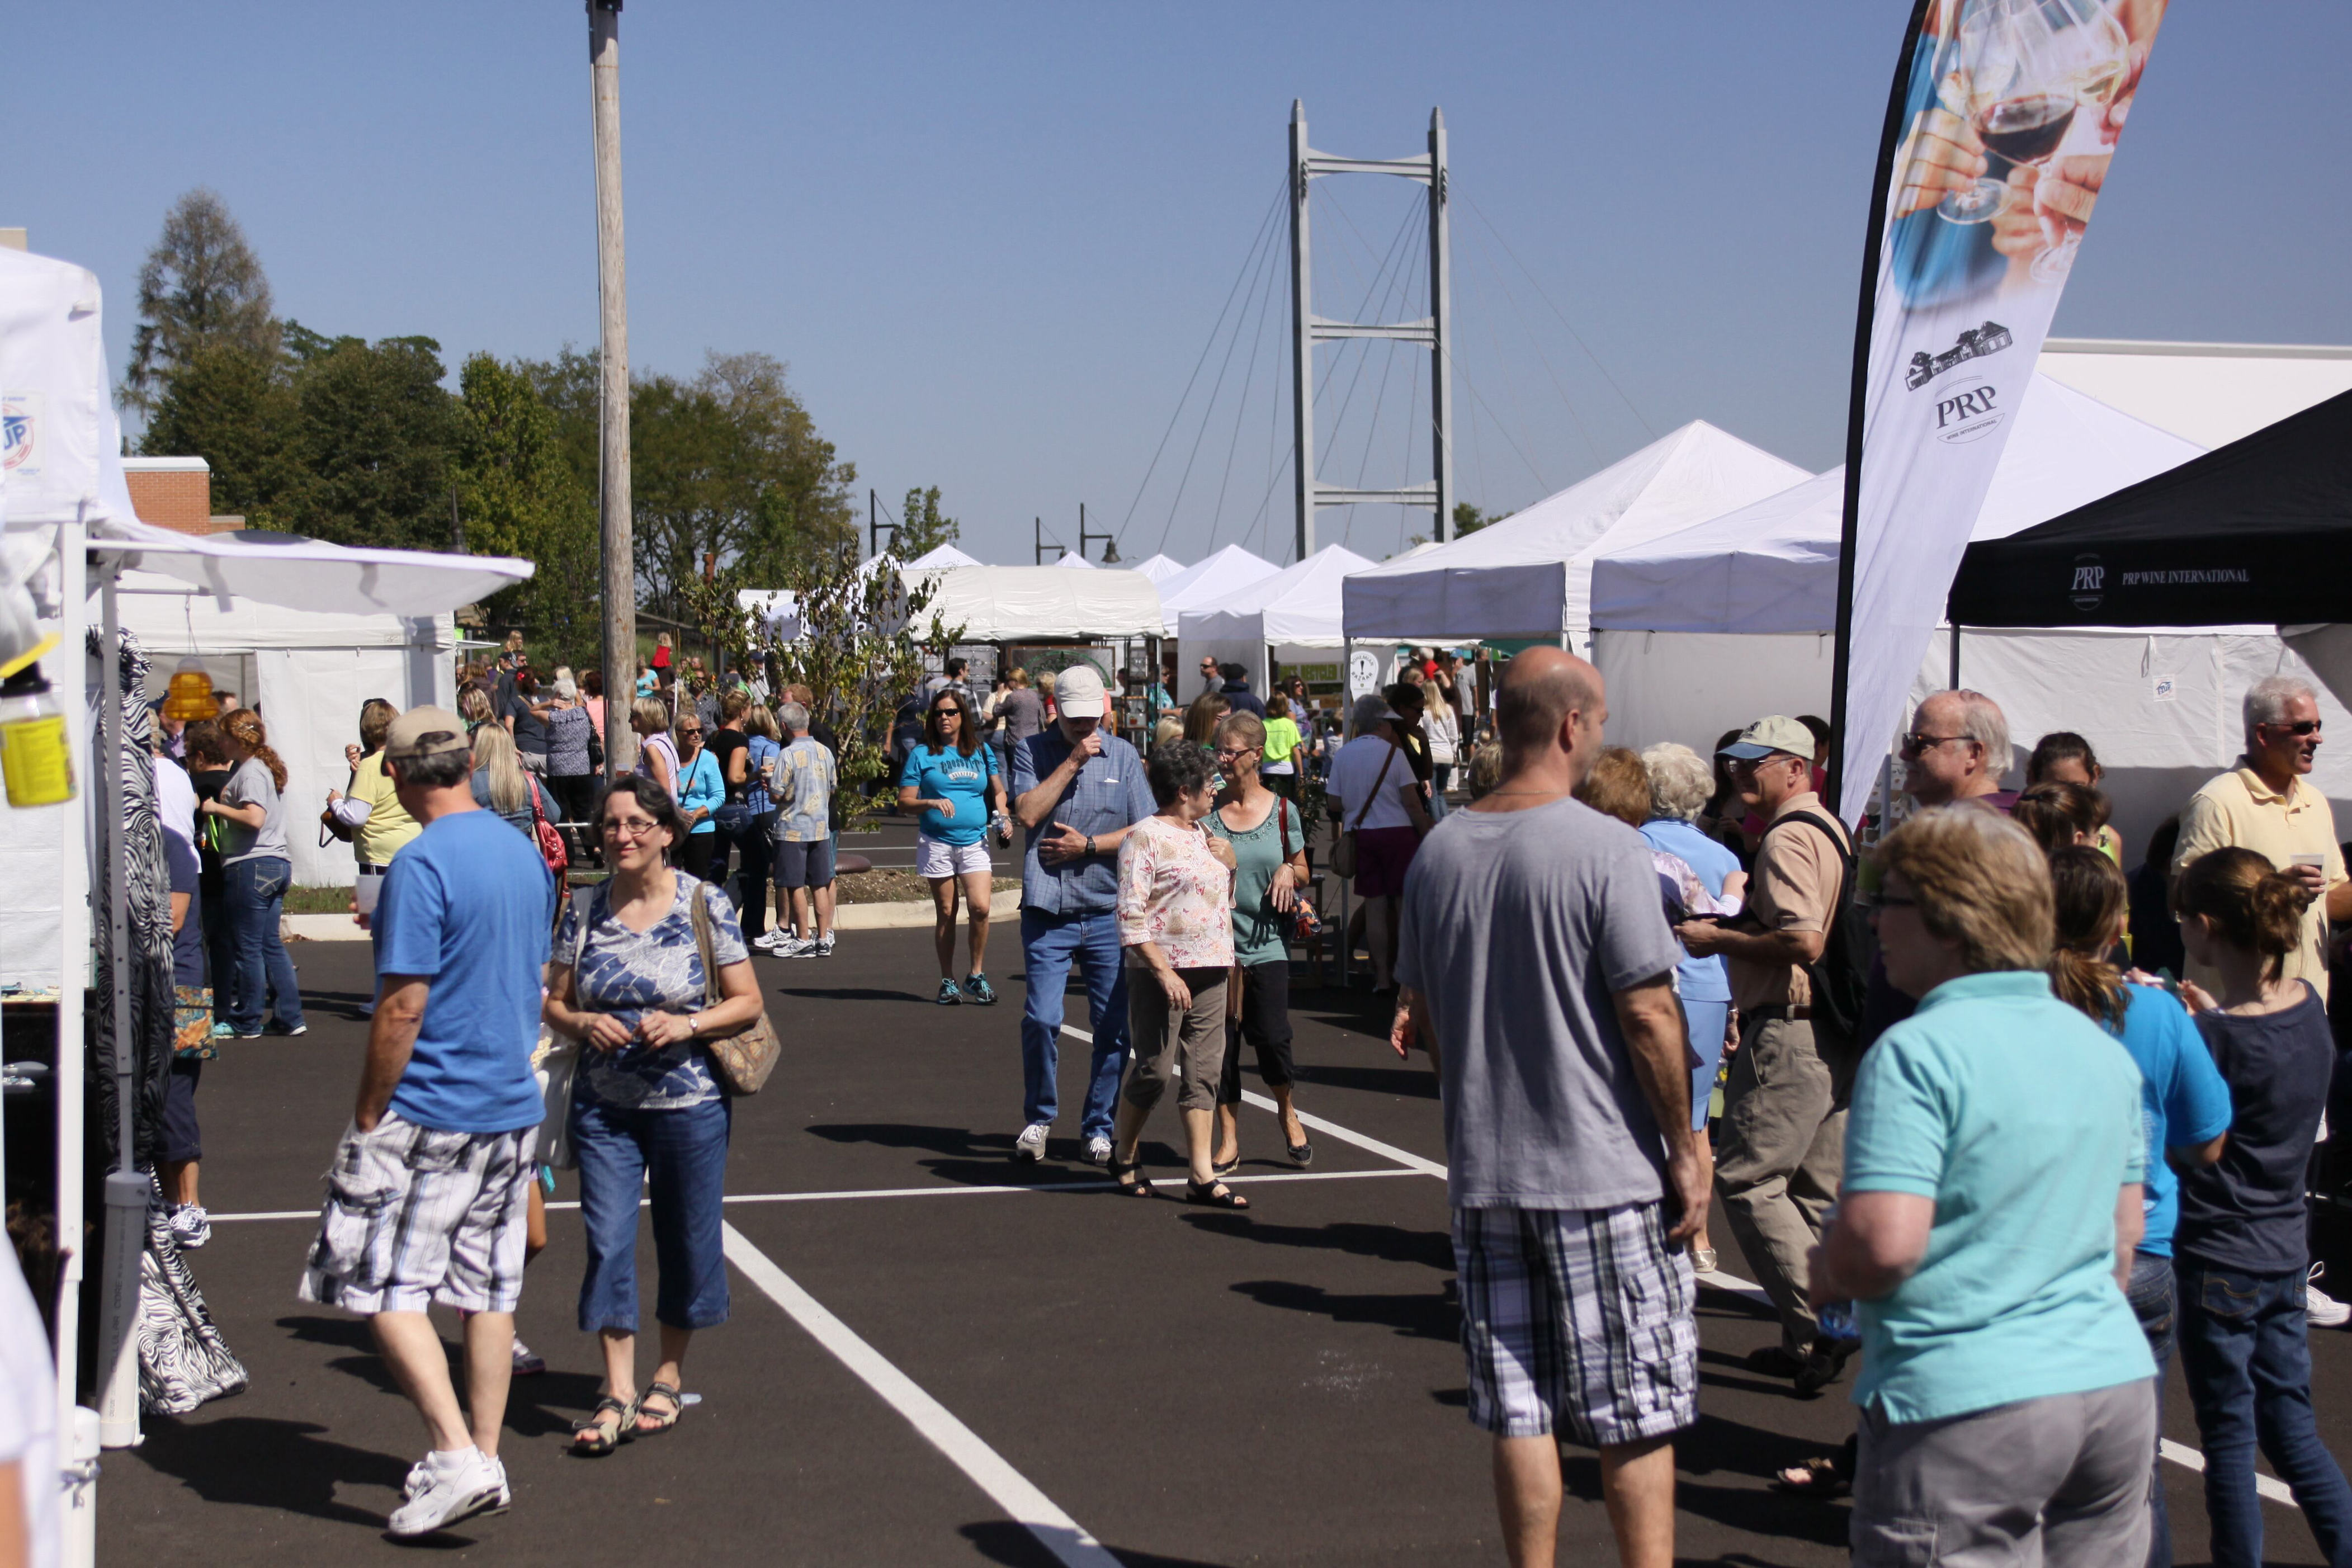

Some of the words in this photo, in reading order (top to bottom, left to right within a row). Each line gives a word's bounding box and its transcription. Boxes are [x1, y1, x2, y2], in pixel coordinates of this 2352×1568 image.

[1936, 385, 1997, 429] PRP
[1959, 419, 1997, 436] INTERNATIONAL
[2071, 566, 2104, 590] PRP
[2123, 572, 2140, 585] PRP
[2141, 571, 2166, 584] WINE
[2169, 569, 2249, 583] INTERNATIONAL
[1351, 672, 1373, 681] BAZAAR
[114, 1279, 122, 1309] CORE
